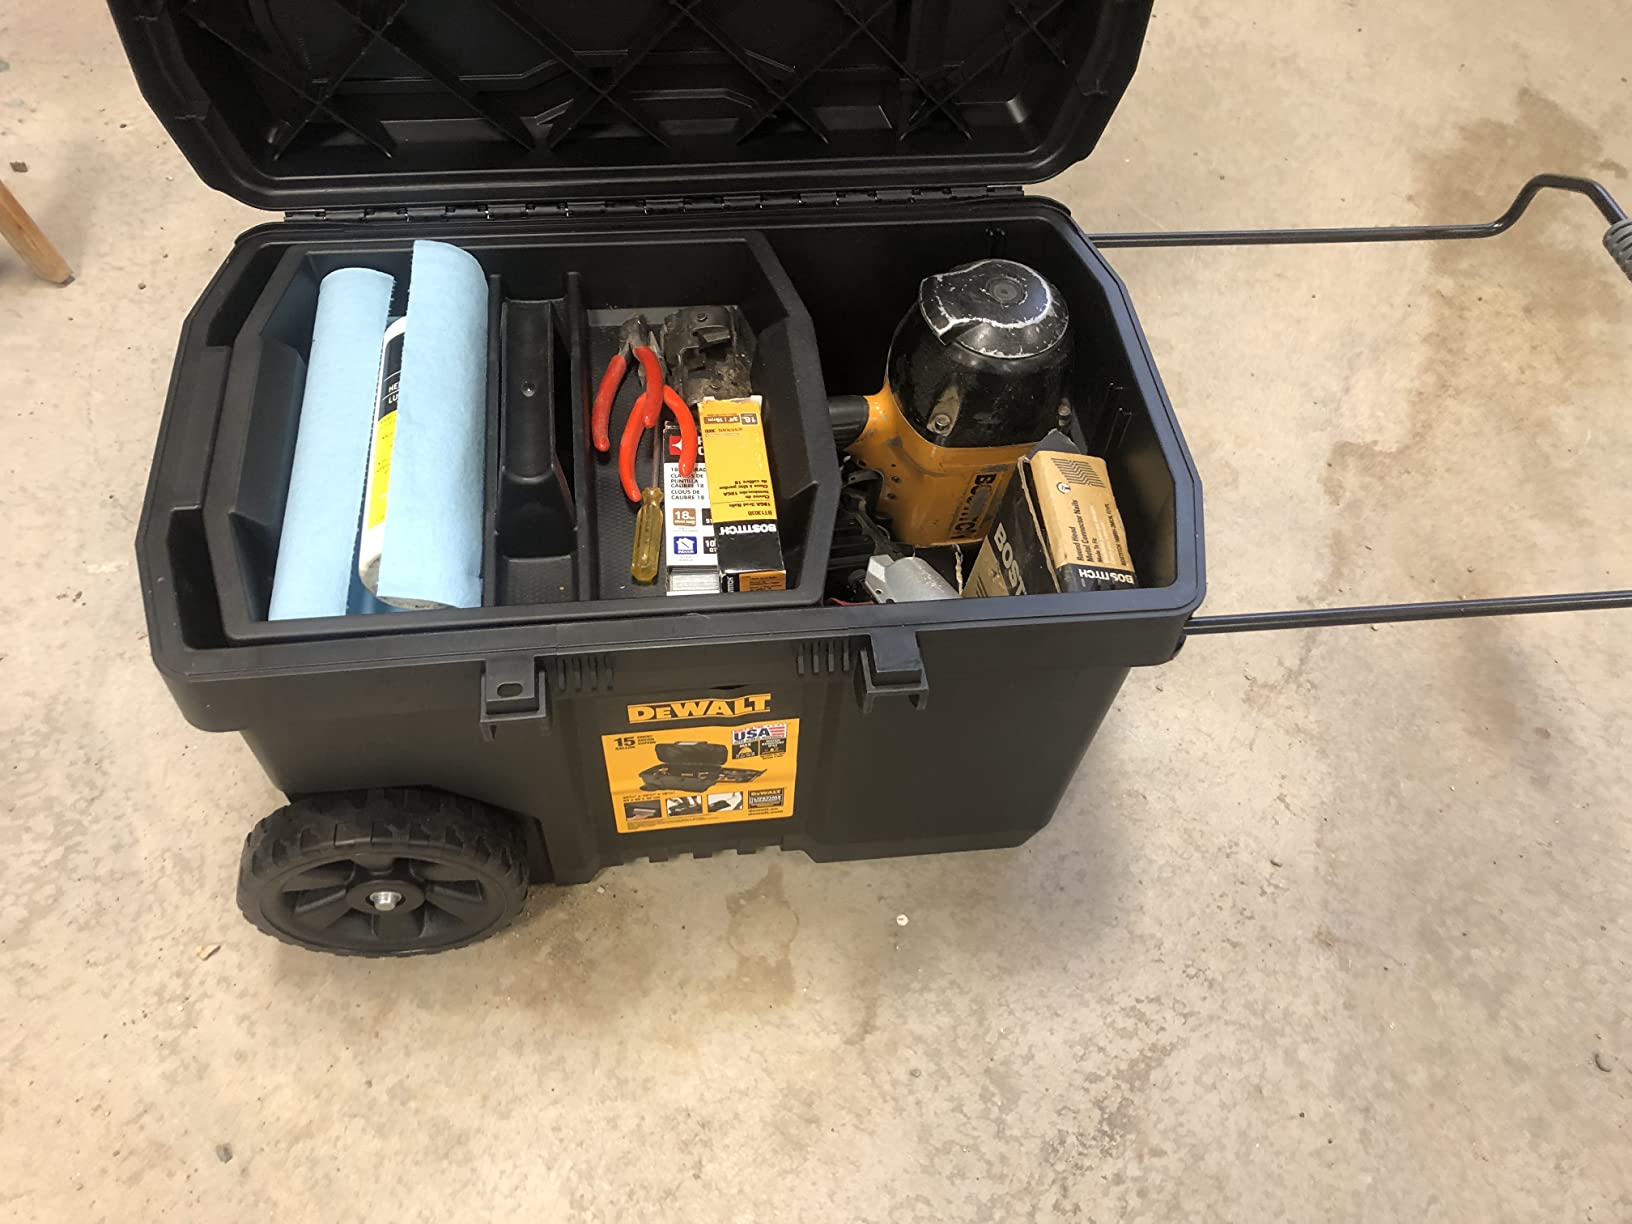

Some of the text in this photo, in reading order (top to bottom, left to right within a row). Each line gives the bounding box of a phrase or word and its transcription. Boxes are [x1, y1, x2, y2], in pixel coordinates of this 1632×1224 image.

[719, 523, 777, 536] BOSTITCH
[993, 522, 1028, 596] BOST
[1078, 568, 1134, 584] BOSTITCH
[629, 694, 771, 721] DEWALT
[734, 727, 771, 741] USA
[613, 737, 636, 748] 15
